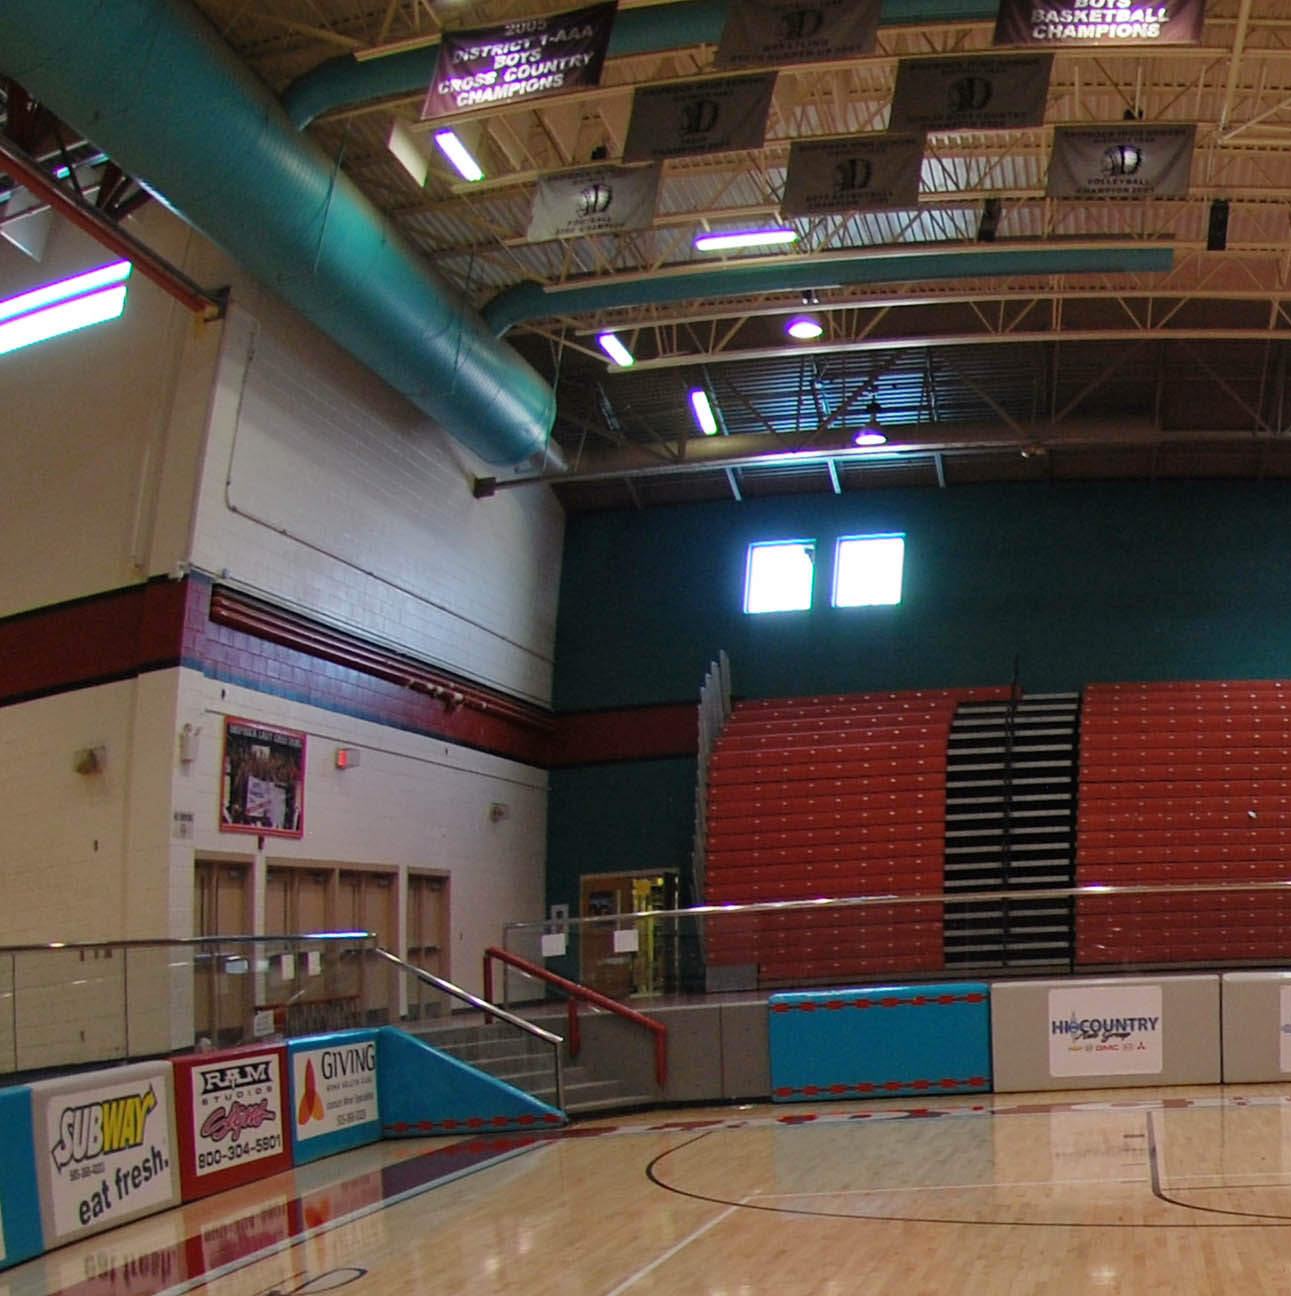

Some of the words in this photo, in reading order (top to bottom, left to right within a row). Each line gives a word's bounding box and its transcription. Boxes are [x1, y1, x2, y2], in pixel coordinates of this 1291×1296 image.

[1031, 8, 1169, 23] BASKETBALL
[1033, 23, 1161, 39] CHAMPIONS
[454, 36, 531, 64] DISTRICT
[540, 25, 593, 46] 1-AAA
[493, 48, 542, 70] BOYS
[437, 71, 497, 95] CROSS
[504, 52, 595, 82] COUNTRY
[456, 74, 564, 107] CHAMPIONS
[204, 1063, 269, 1091] RAM
[321, 1043, 376, 1080] GIVING
[202, 1086, 272, 1106] STUDIOS
[51, 1082, 157, 1173] SUBWAY
[79, 1180, 112, 1225] eat
[115, 1145, 169, 1200] fresh.
